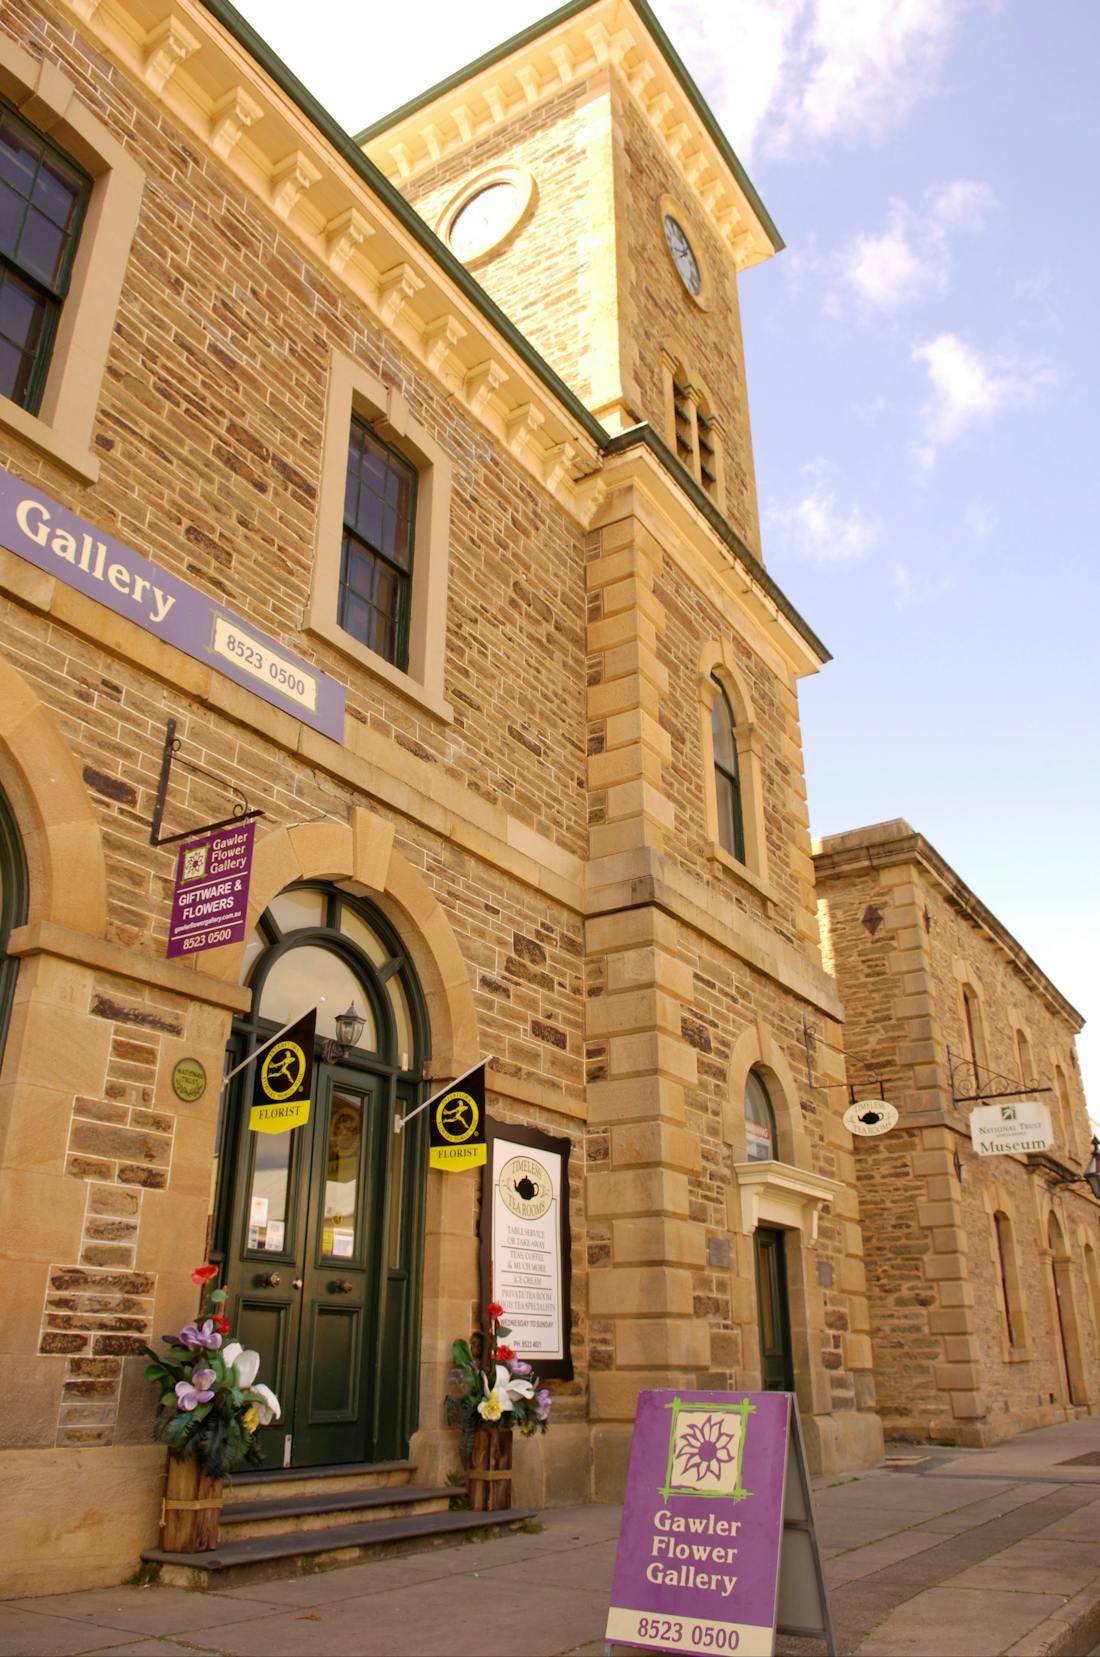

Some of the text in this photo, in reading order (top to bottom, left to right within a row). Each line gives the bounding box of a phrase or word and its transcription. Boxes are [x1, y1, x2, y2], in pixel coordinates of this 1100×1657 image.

[15, 499, 176, 622] Gallery
[226, 634, 305, 695] 8523 0500
[212, 833, 248, 850] Gawler
[211, 845, 246, 862] Flower
[210, 856, 247, 874] Gallery
[178, 879, 242, 906] GIFTWARE &
[182, 896, 235, 920] FLOWERS
[182, 928, 232, 950] 8523 0500
[259, 1105, 301, 1120] FLORIST
[979, 1124, 1017, 1135] NATIONAL
[438, 1147, 479, 1160] FLORIST
[979, 1139, 1047, 1154] Museum
[512, 1159, 542, 1179] TIMELESS
[521, 1200, 546, 1217] ROOMS
[654, 1509, 741, 1537] Gawler
[651, 1535, 738, 1564] Flower
[646, 1562, 738, 1597] Gallery
[637, 1617, 740, 1650] 8523 0500
